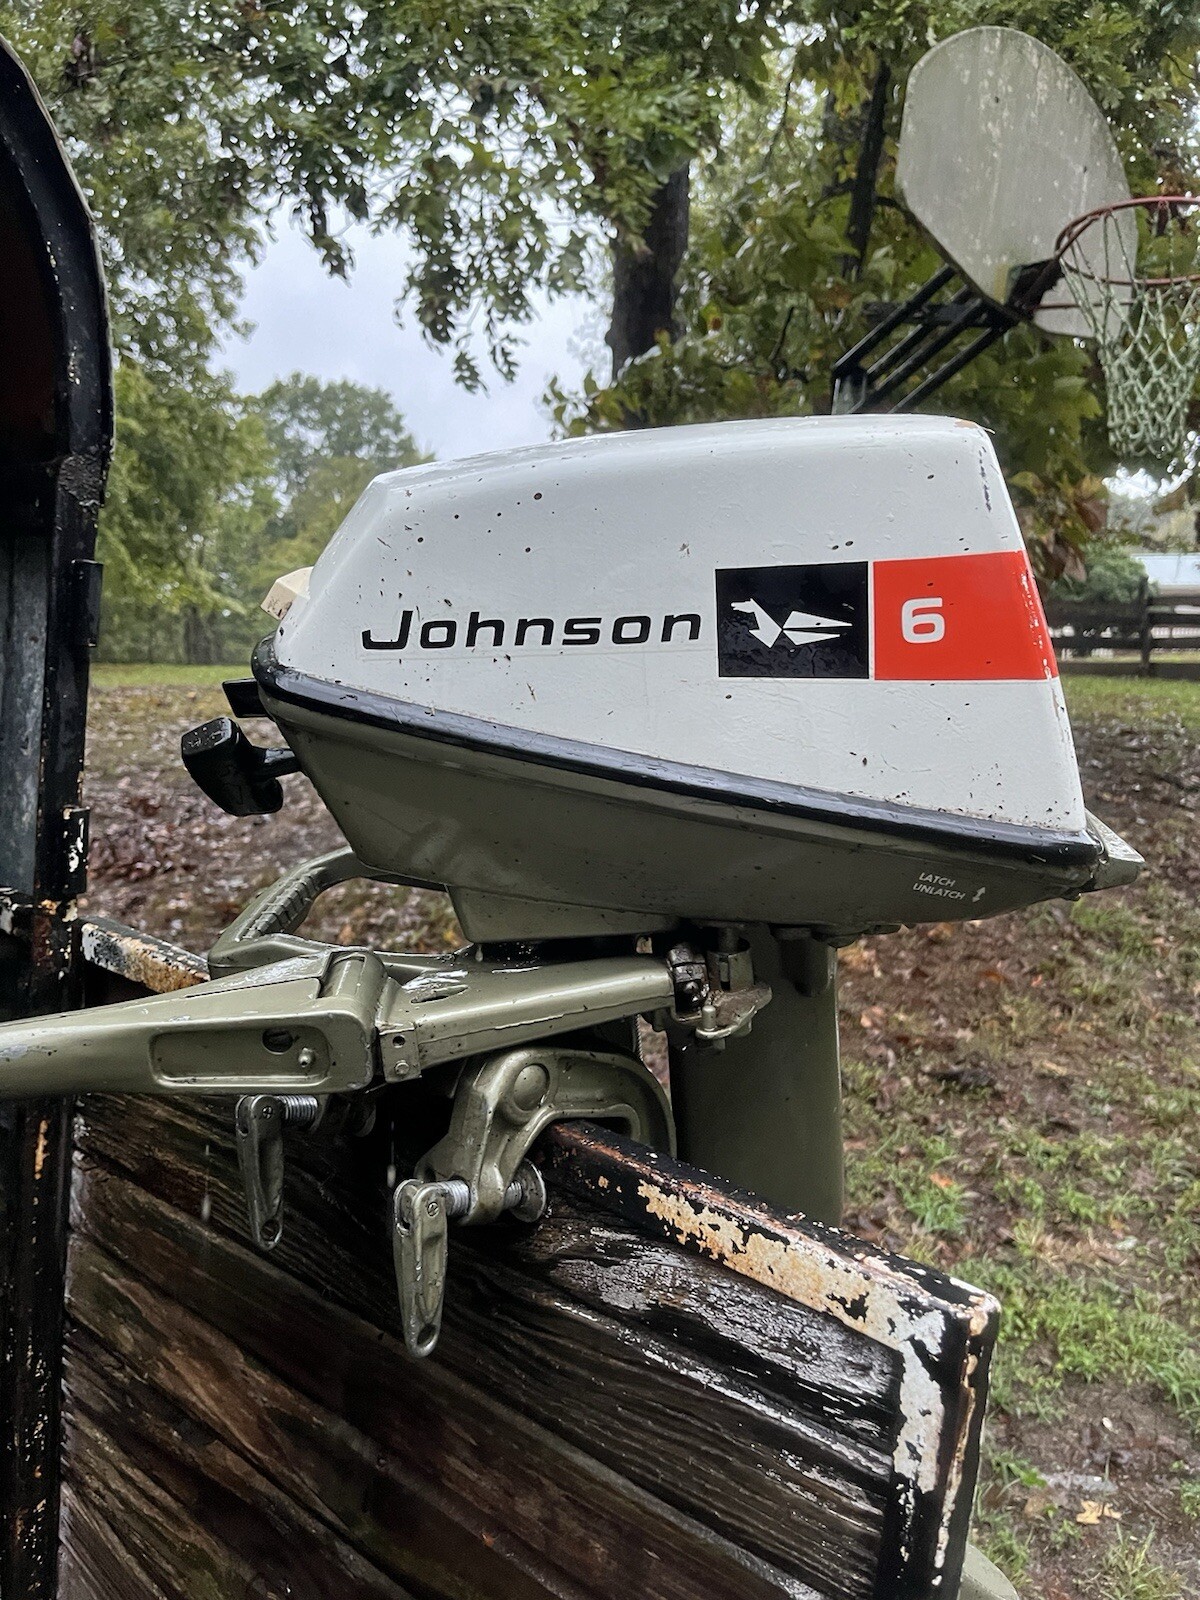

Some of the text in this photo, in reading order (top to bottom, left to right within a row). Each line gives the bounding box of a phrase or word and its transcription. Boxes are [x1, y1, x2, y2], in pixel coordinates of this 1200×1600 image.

[362, 610, 702, 650] Johnson
[901, 598, 945, 644] 6
[912, 882, 966, 899] UNLATCH
[919, 872, 956, 887] LATCH
